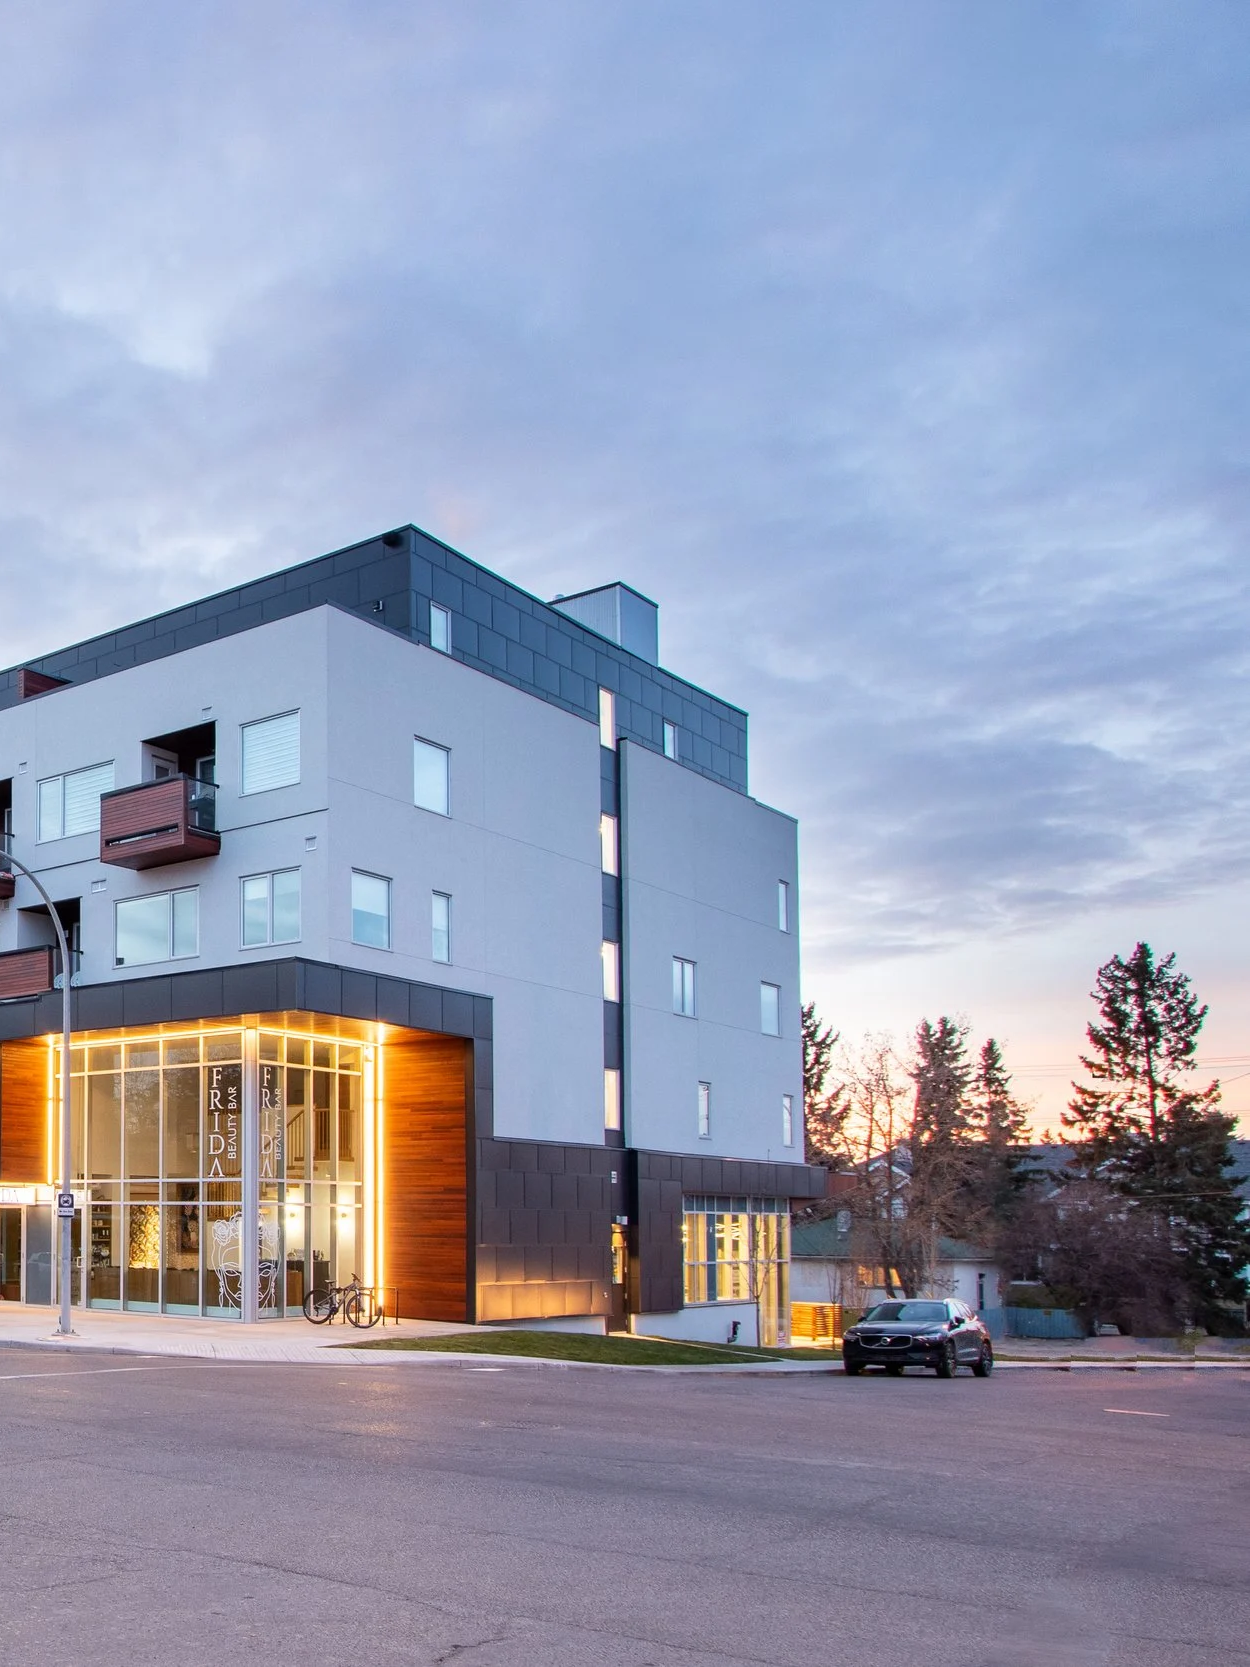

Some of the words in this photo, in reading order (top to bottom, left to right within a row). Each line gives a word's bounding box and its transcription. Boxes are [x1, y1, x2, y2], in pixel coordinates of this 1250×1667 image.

[208, 1067, 226, 1178] FRIDA
[228, 1086, 237, 1109] BAR
[228, 1113, 237, 1159] BEAUTY
[260, 1067, 274, 1178] FRIDA
